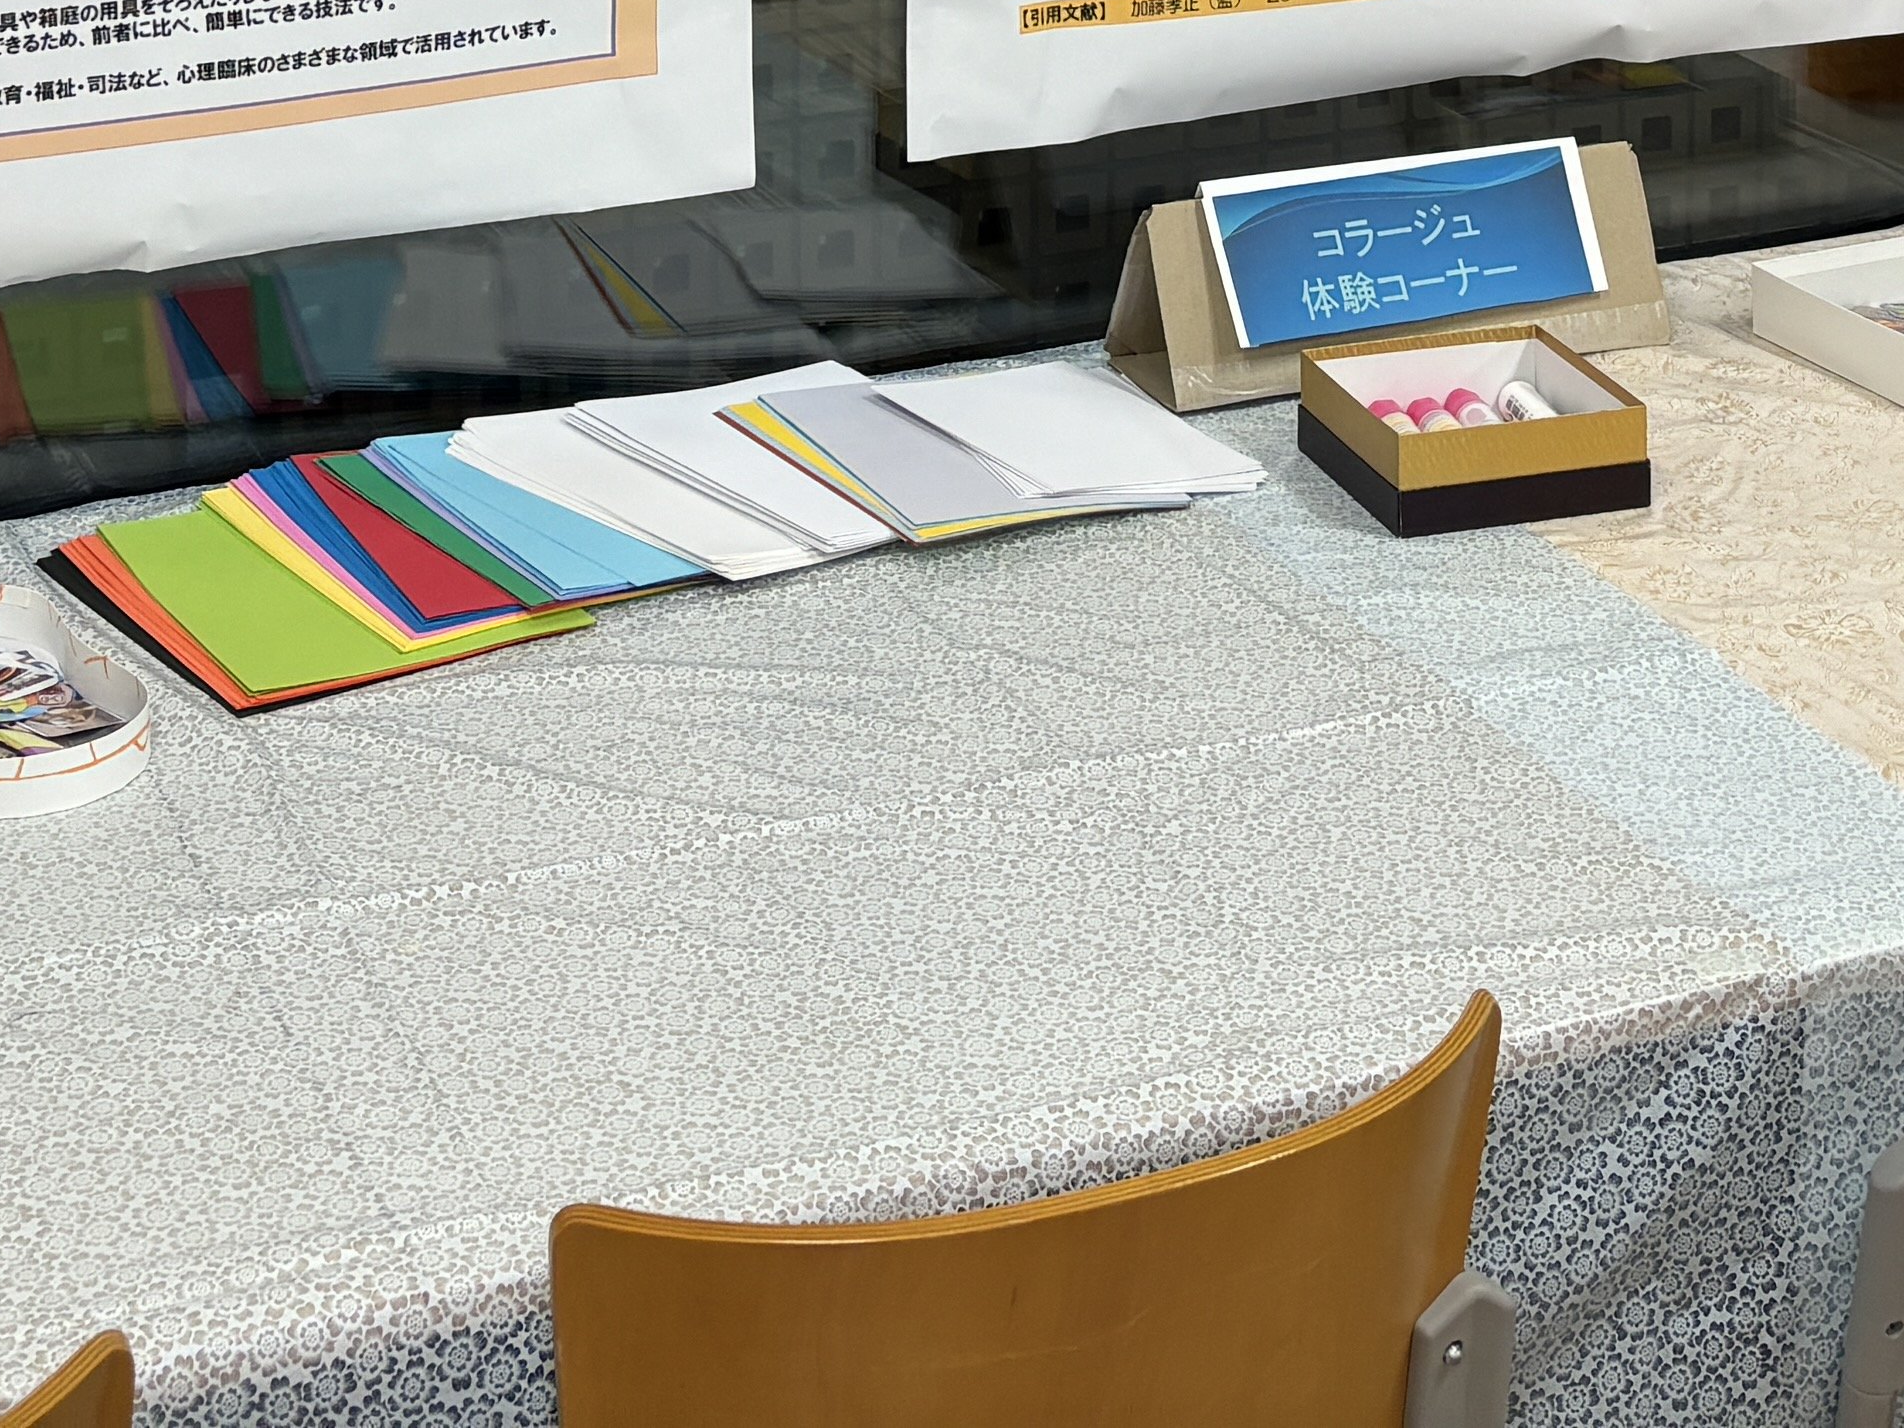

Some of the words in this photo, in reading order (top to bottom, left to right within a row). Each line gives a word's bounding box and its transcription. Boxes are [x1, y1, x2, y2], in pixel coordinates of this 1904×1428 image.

[1313, 203, 1480, 258] コラージュ
[1301, 258, 1518, 321] 体験コーナー
